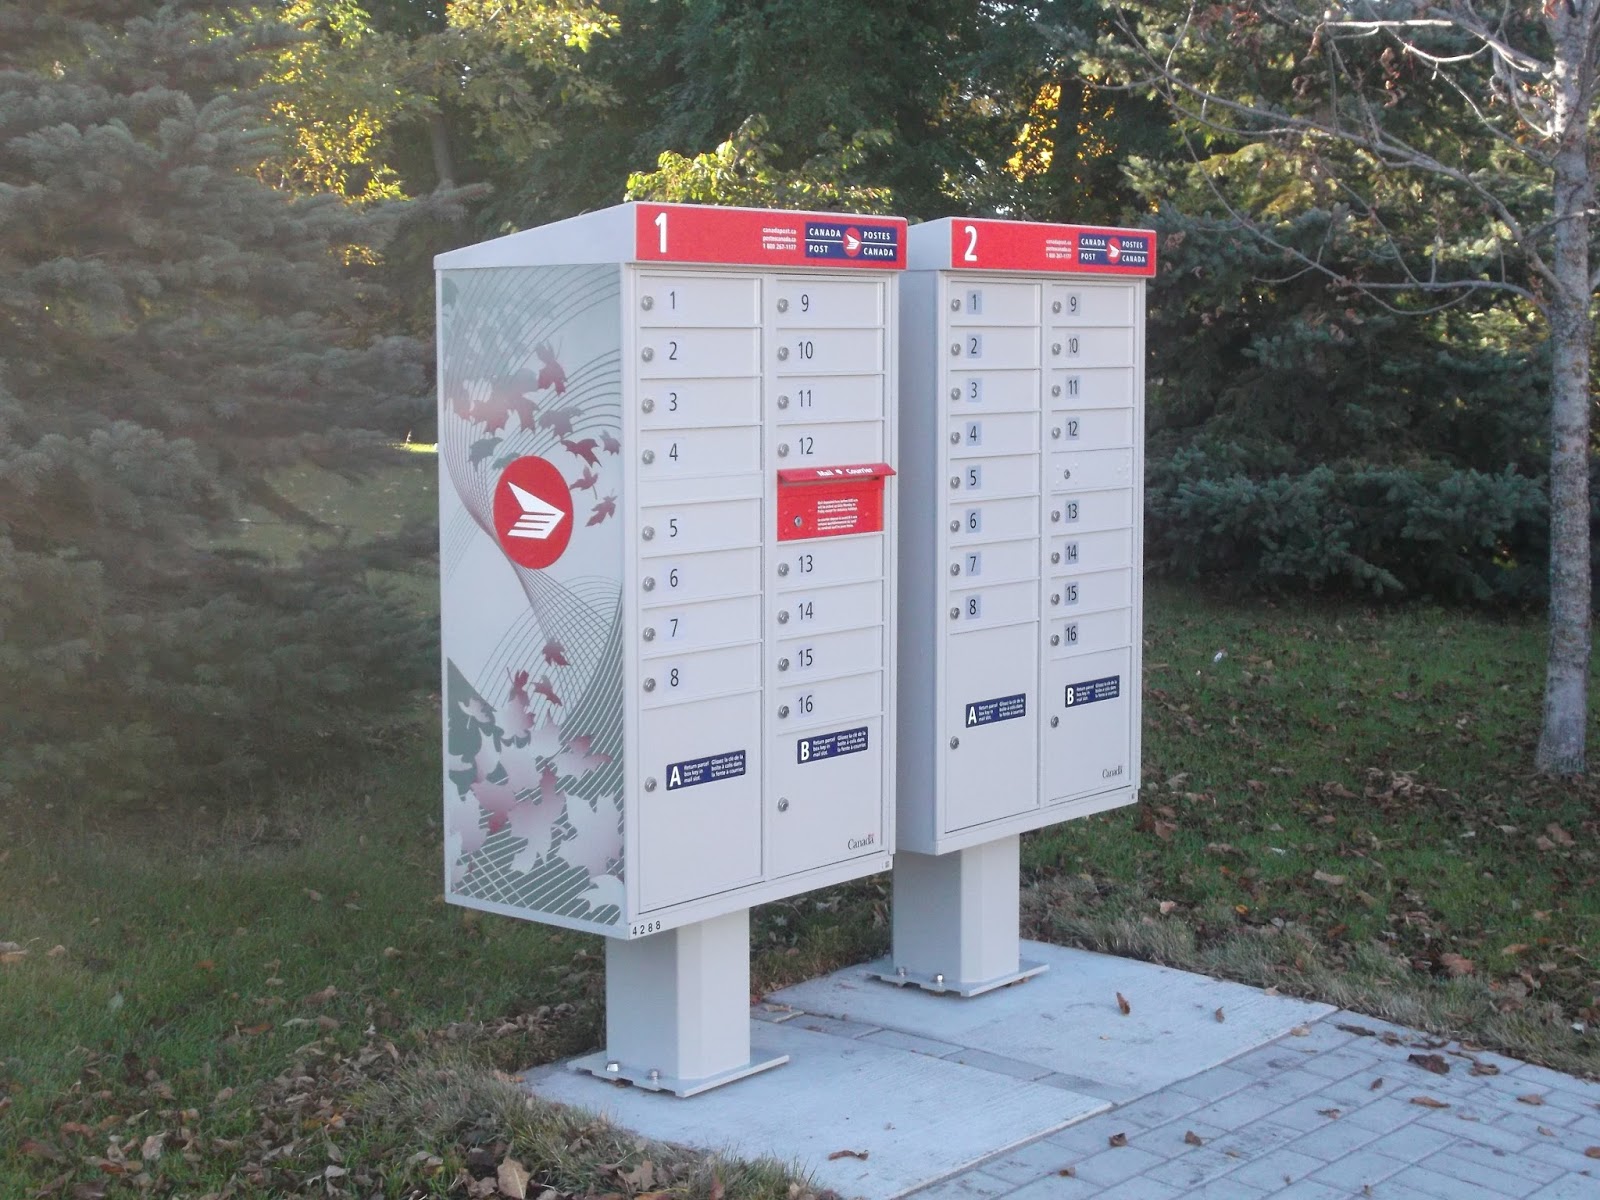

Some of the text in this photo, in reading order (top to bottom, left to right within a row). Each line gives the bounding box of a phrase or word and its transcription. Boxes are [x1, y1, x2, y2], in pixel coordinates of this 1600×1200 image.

[654, 212, 667, 253] 1
[809, 227, 841, 238] CANADA
[863, 231, 891, 241] POSTES
[808, 244, 829, 253] POST
[964, 225, 978, 262] 2
[1080, 237, 1106, 247] CANADA
[1122, 240, 1143, 249] POSTES
[863, 247, 894, 257] CANADA
[1080, 252, 1096, 261] POST
[1121, 255, 1146, 263] CANADA
[670, 291, 676, 310] 1
[801, 294, 809, 313] 9
[972, 294, 977, 311] 1
[1070, 296, 1077, 313] 9
[669, 341, 678, 361] 2
[798, 341, 814, 360] 10
[970, 337, 978, 355] 2
[1068, 337, 1079, 354] 10
[970, 381, 978, 399] 3
[1068, 379, 1078, 395] 11
[669, 392, 678, 412] 3
[798, 389, 812, 408] 11
[969, 425, 977, 442] 4
[1067, 420, 1078, 437] 12
[669, 443, 679, 462] 4
[799, 436, 814, 455] 12
[816, 469, 835, 477] Mail
[845, 467, 874, 475] Courrier
[970, 469, 977, 486] 5
[1067, 503, 1078, 519] 13
[669, 518, 678, 538] 5
[969, 512, 977, 529] 6
[1067, 544, 1077, 561] 14
[798, 554, 813, 573] 13
[969, 555, 977, 572] 7
[669, 568, 679, 588] 6
[1066, 585, 1077, 601] 15
[798, 601, 814, 621] 14
[969, 598, 977, 616] 8
[670, 618, 679, 637] 7
[1066, 625, 1077, 642] 16
[798, 648, 813, 667] 15
[670, 668, 679, 687] 8
[798, 694, 813, 714] 16
[1067, 687, 1074, 705] B
[968, 706, 977, 725] A
[801, 741, 810, 761] B
[669, 765, 682, 788] A
[632, 920, 661, 936] 4288
